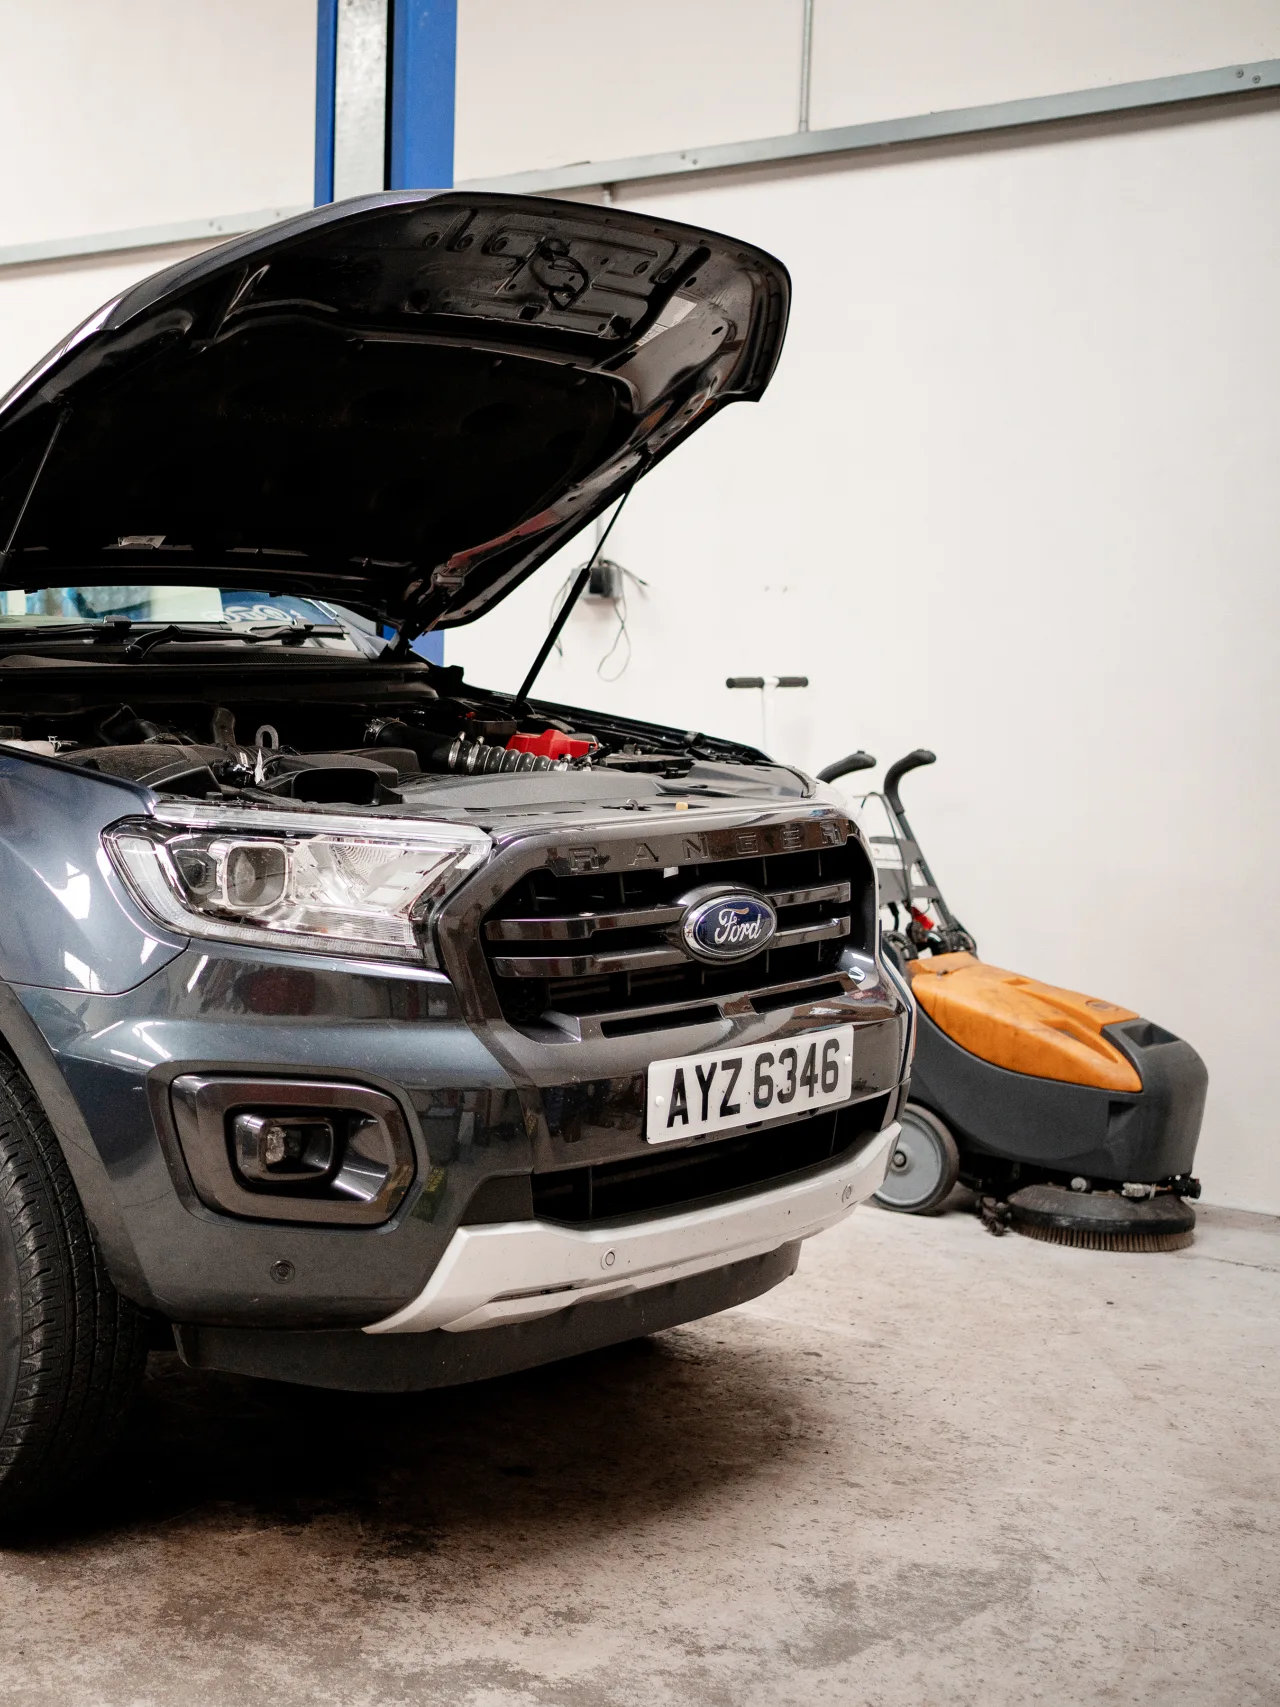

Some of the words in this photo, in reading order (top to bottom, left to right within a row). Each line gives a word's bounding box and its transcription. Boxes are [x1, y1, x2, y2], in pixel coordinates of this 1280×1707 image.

[569, 820, 843, 872] RANGER
[714, 907, 762, 945] Ford
[666, 1056, 743, 1129] AYZ
[753, 1038, 840, 1110] 6346
